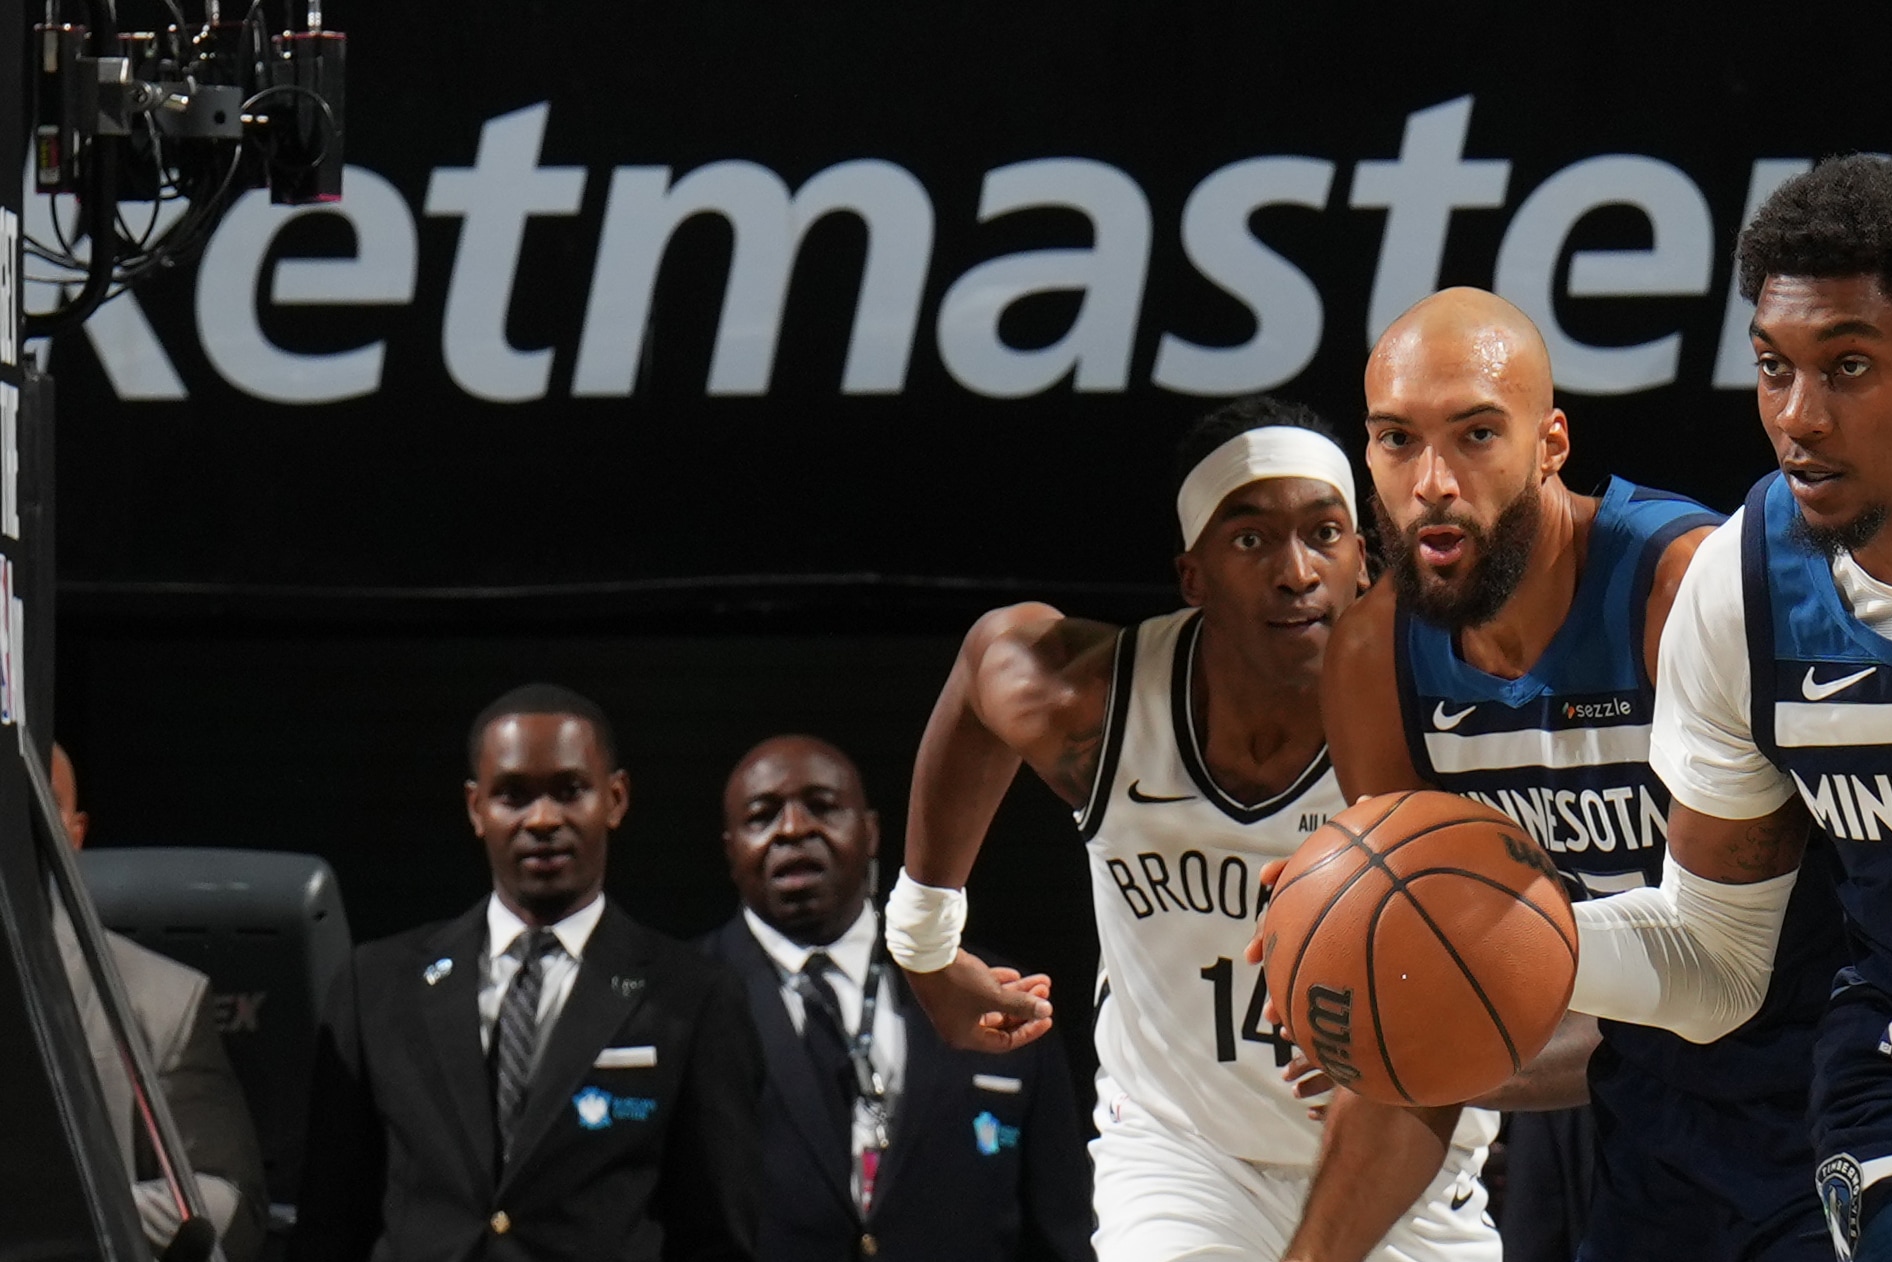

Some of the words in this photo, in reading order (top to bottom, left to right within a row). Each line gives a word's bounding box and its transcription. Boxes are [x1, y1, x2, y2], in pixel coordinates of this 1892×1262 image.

[1575, 697, 1632, 719] sezzle
[1298, 813, 1319, 832] All
[1459, 784, 1668, 853] NESOTA
[1106, 850, 1273, 921] BROO
[1201, 955, 1293, 1068] 14
[1306, 983, 1364, 1094] Wil
